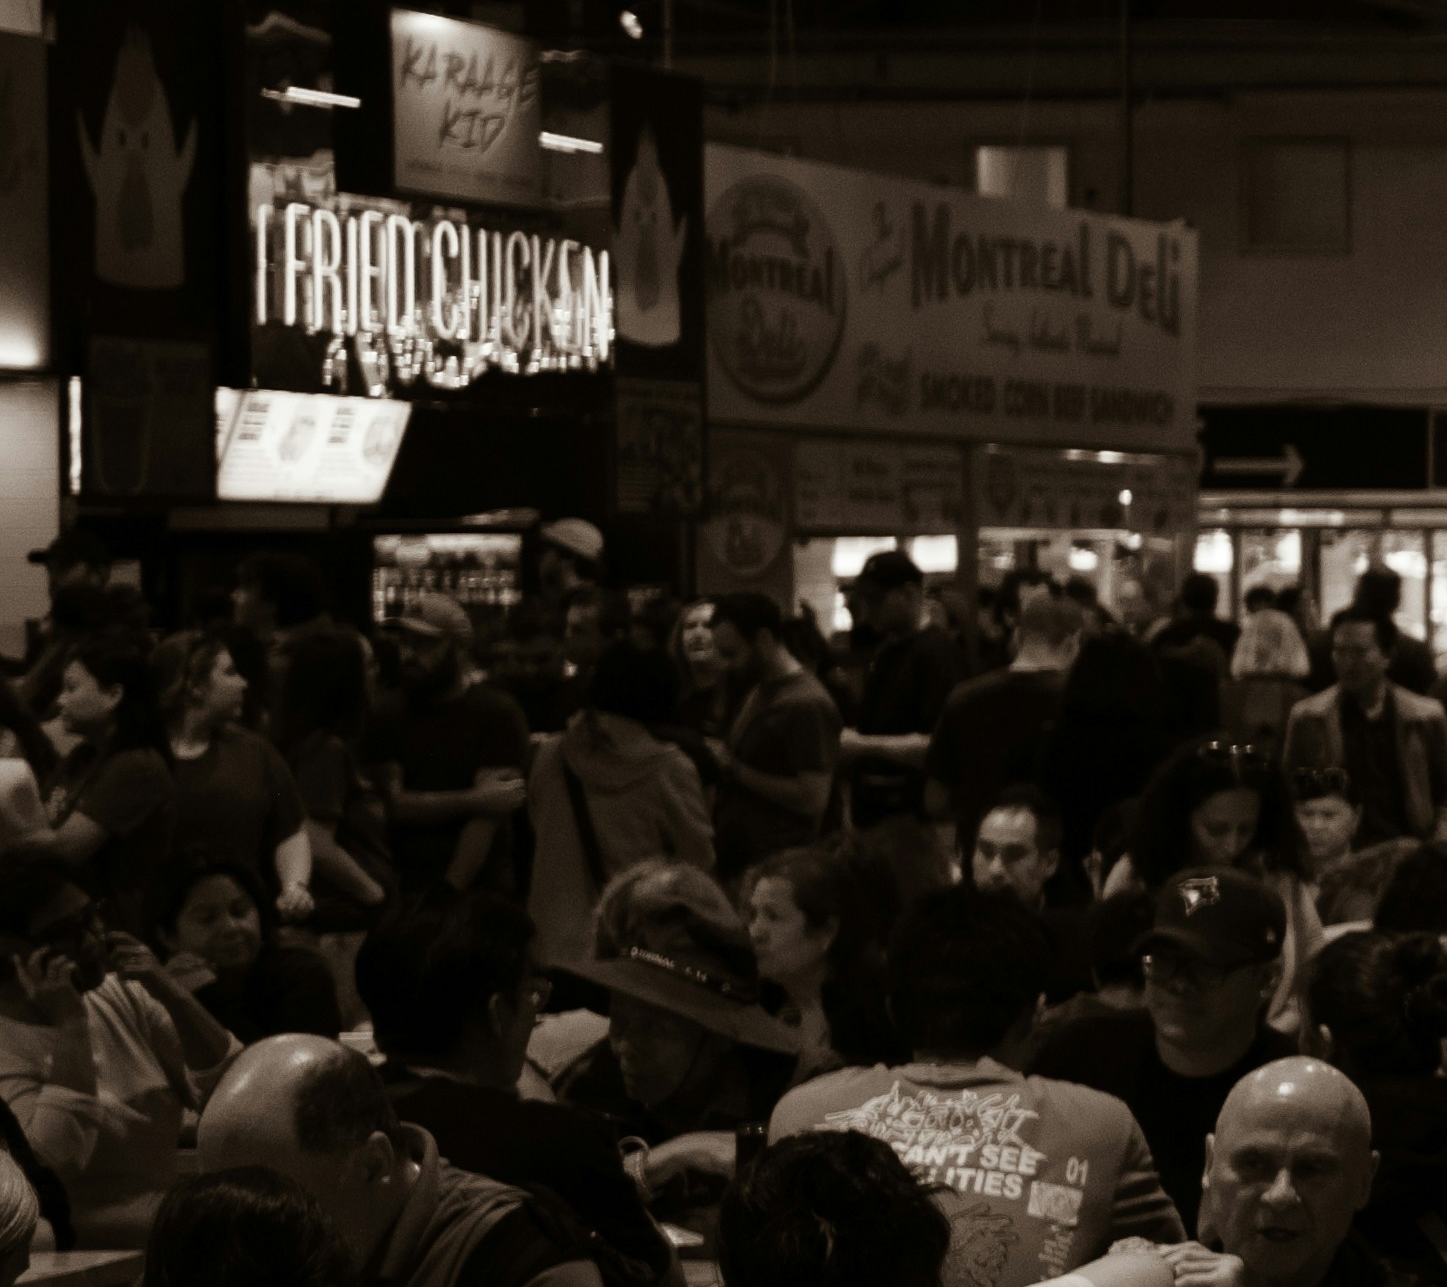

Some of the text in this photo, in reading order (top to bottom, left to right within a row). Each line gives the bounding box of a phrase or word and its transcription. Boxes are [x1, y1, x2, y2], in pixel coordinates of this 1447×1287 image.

[439, 98, 504, 154] KID
[283, 202, 611, 364] FRIED CHICKEN
[980, 1144, 1040, 1175] SEE
[1066, 1157, 1089, 1186] 01
